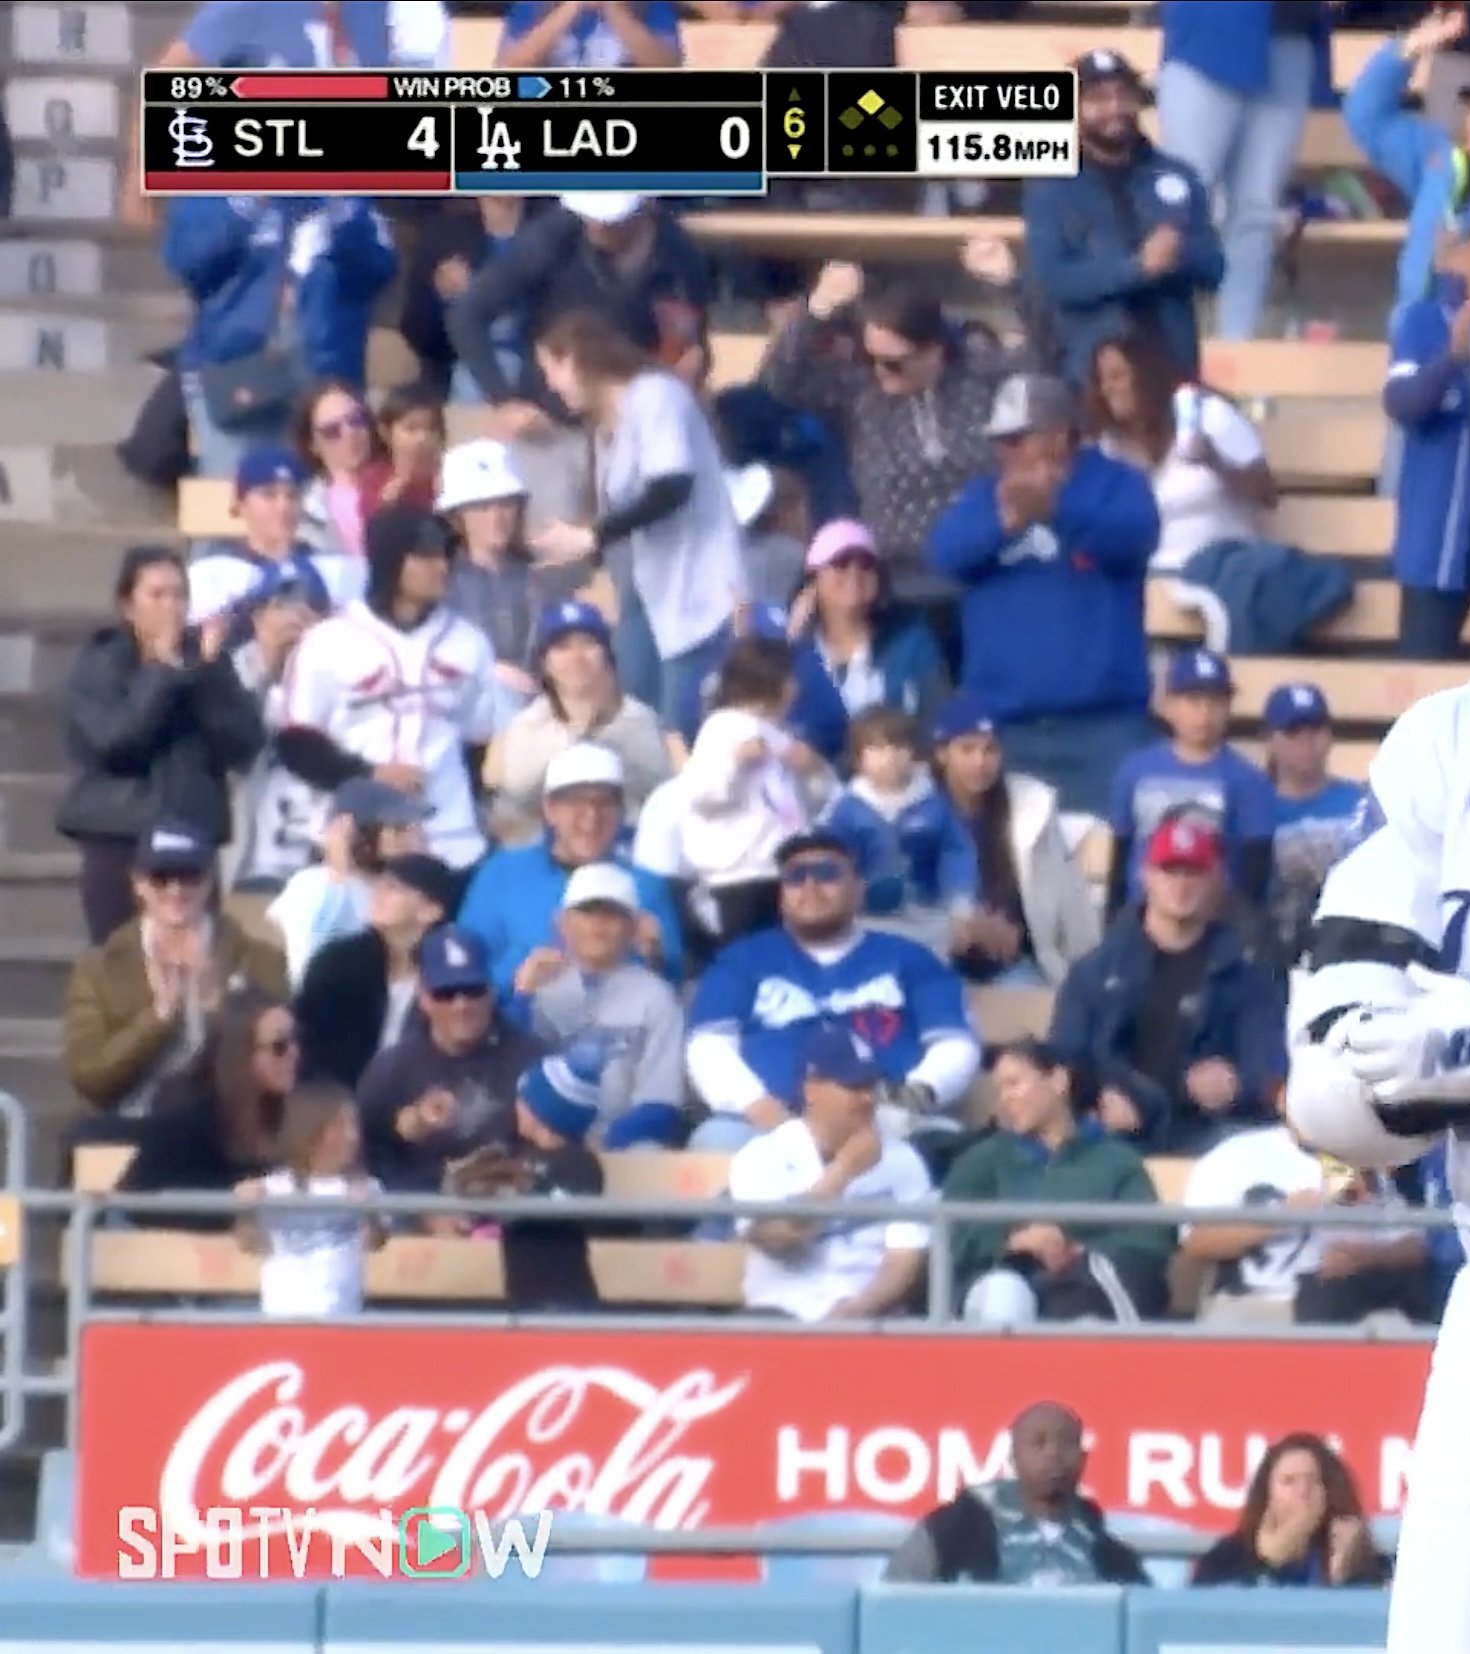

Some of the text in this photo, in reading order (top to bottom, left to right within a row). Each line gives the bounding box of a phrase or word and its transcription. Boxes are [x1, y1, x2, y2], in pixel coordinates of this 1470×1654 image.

[159, 1360, 750, 1533] Coca-Cola
[774, 1425, 1097, 1506] HOM
[1127, 1432, 1344, 1509] RU
